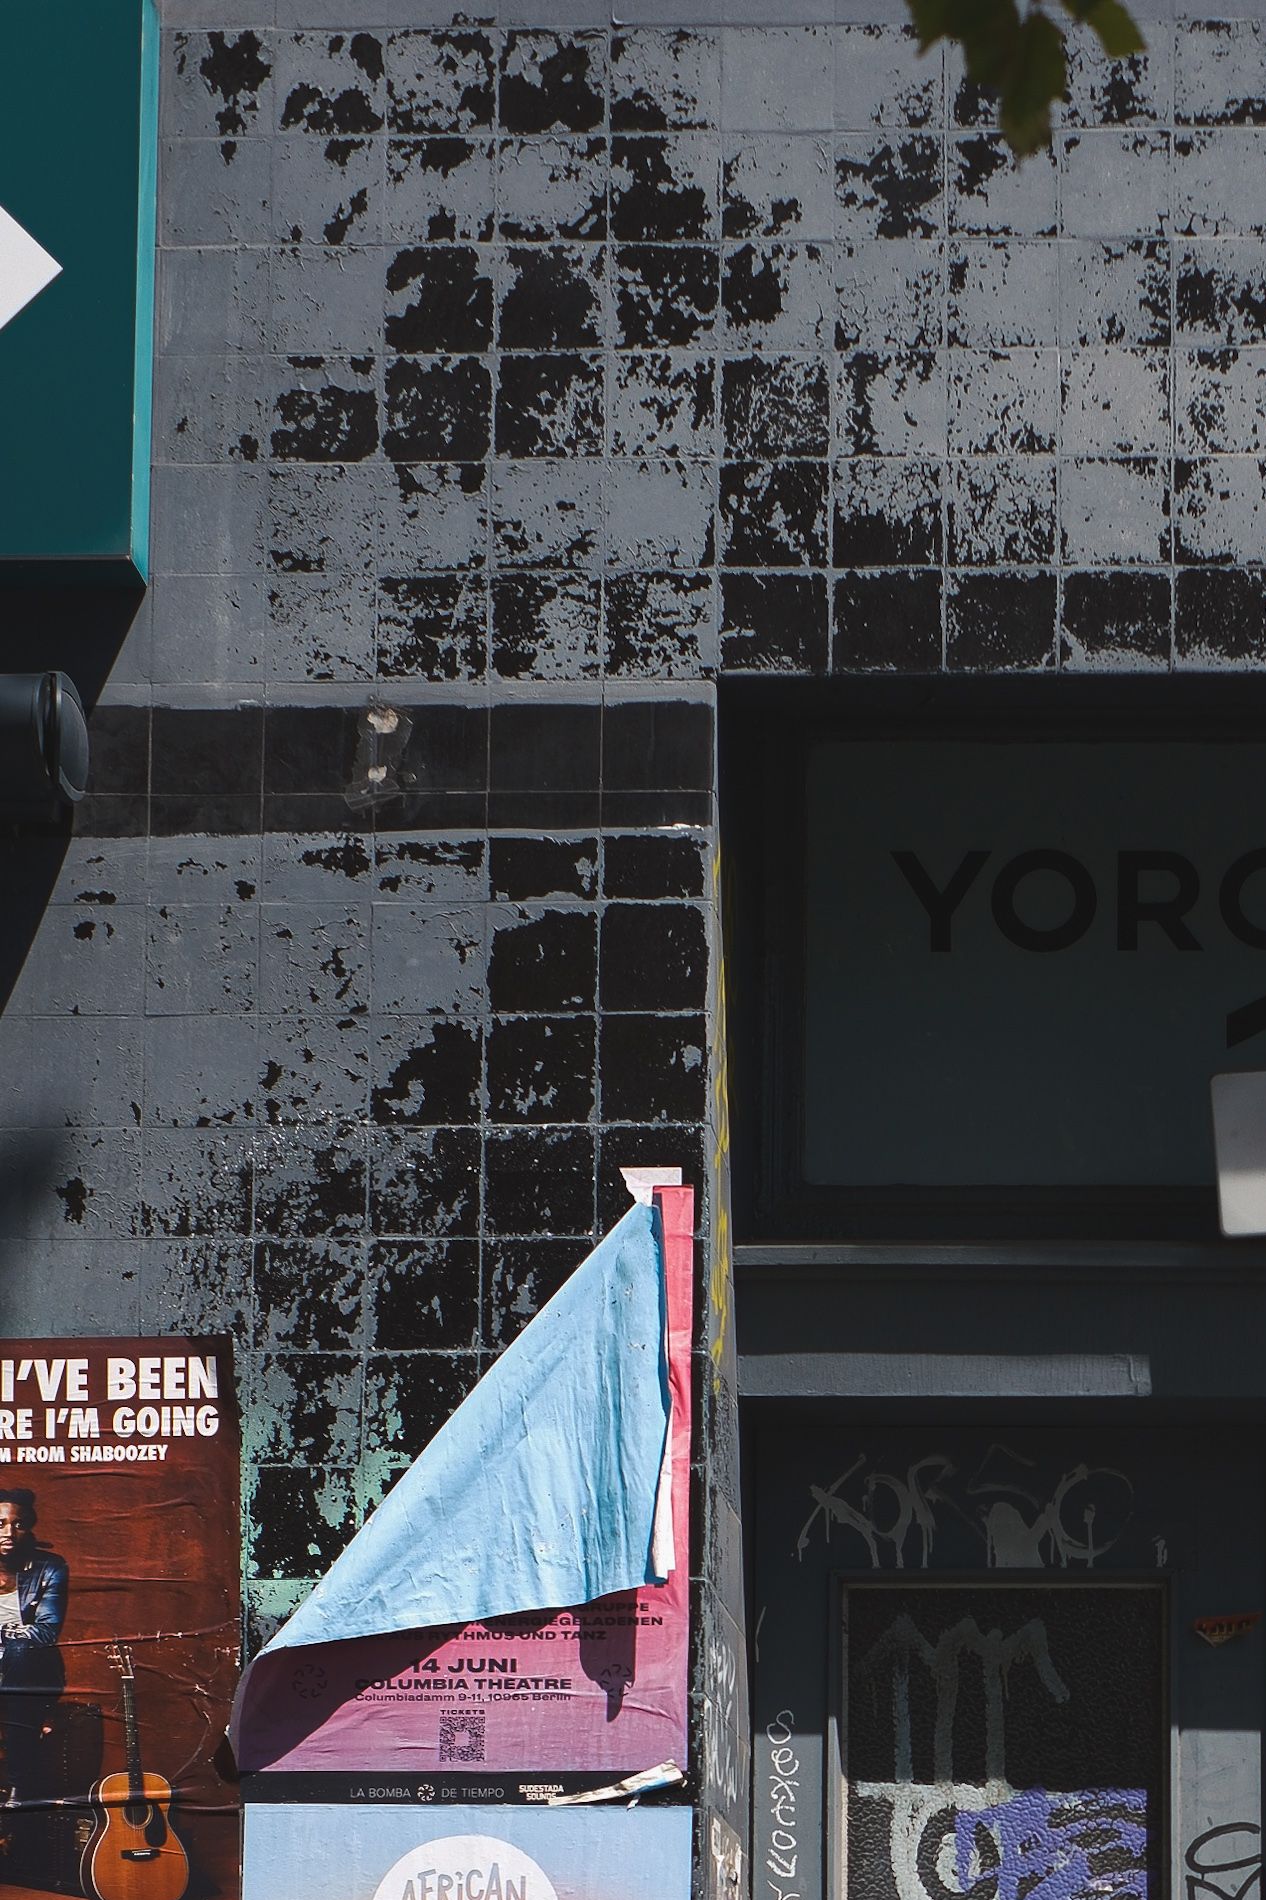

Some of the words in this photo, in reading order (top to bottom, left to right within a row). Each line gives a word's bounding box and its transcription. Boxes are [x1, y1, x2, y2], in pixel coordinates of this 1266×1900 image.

[1, 1358, 89, 1402] I'VE
[107, 1356, 219, 1401] BEEN
[46, 1407, 100, 1439] I'M
[112, 1404, 220, 1438] GOING
[17, 1445, 65, 1463] FROM
[70, 1444, 168, 1463] SHABOOZEY
[409, 1658, 440, 1674] 14
[448, 1658, 518, 1674] JUNI
[355, 1678, 466, 1691] COLUMBIA
[474, 1678, 573, 1691] THEATRE
[355, 1692, 455, 1702] Columbiadamm
[488, 1693, 530, 1703] 10965
[532, 1693, 572, 1703] Berlin
[350, 1788, 365, 1799] LA
[368, 1788, 412, 1799] BOMBA
[441, 1788, 458, 1799] DE
[462, 1788, 505, 1799] TIEMPO
[518, 1784, 564, 1793] SUDESTADA
